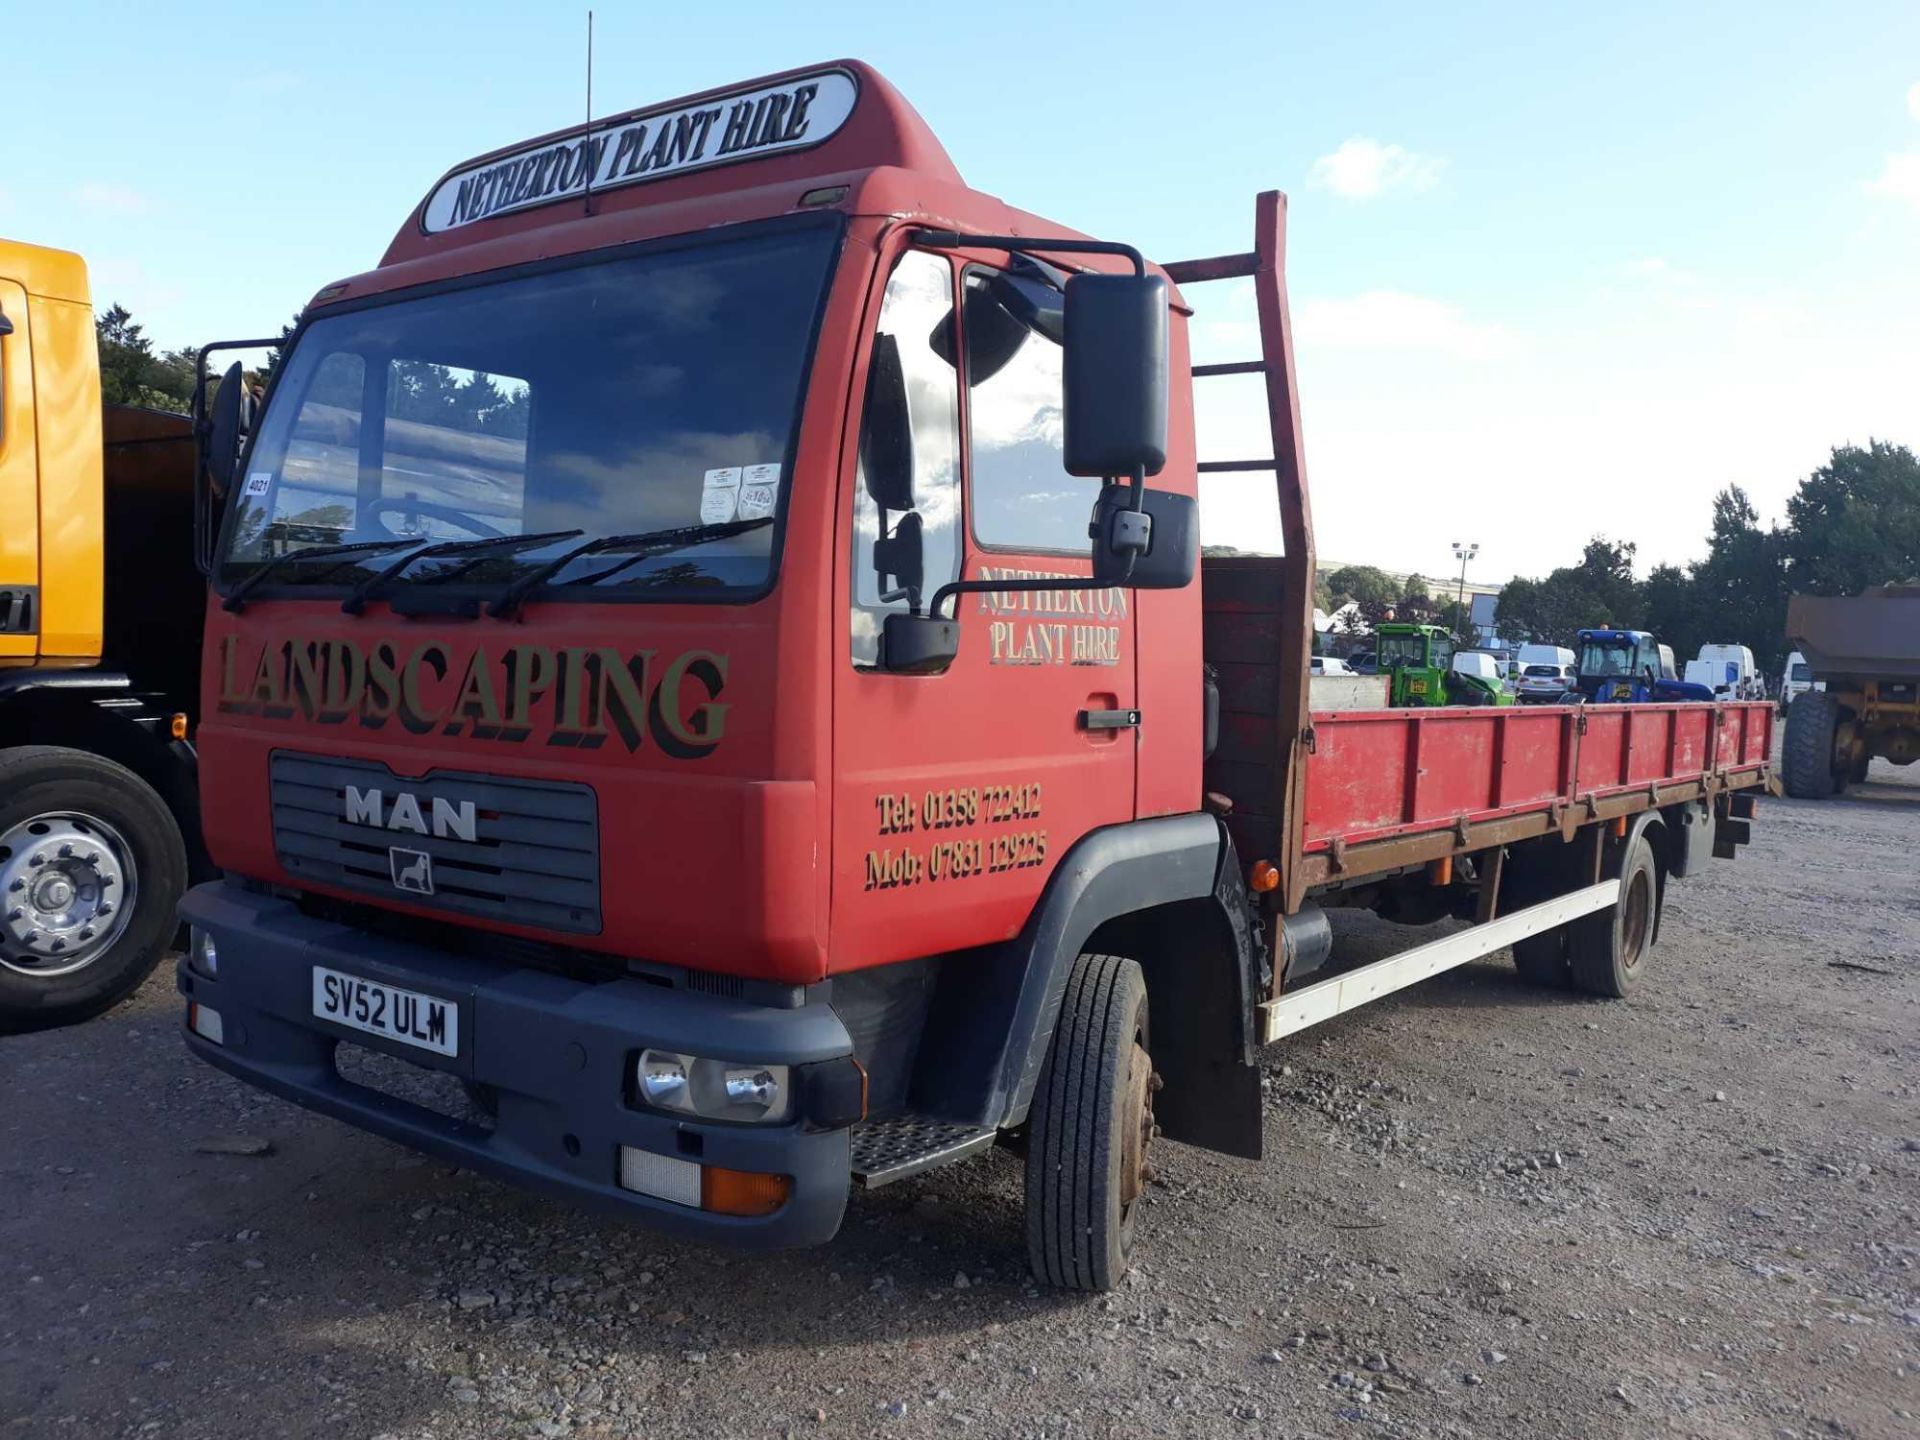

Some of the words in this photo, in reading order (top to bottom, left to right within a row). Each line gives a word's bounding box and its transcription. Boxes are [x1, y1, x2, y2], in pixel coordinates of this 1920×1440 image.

[447, 132, 613, 227] NETHERTON
[603, 104, 722, 181] PLANT
[715, 83, 820, 154] HIRE
[977, 566, 1128, 621] NETHERTON
[989, 621, 1067, 666] PLANT
[1070, 624, 1120, 666] HIRE
[218, 633, 731, 760] LANDSCAPING
[345, 785, 478, 842] MAN
[876, 792, 917, 835] Tel:
[921, 786, 978, 831] 01358
[982, 782, 1041, 824] 722412
[864, 847, 924, 891] Mob:
[928, 838, 983, 882] 07831
[988, 829, 1047, 874] 129225
[323, 974, 386, 1029] SV52
[393, 993, 446, 1046] ULM
